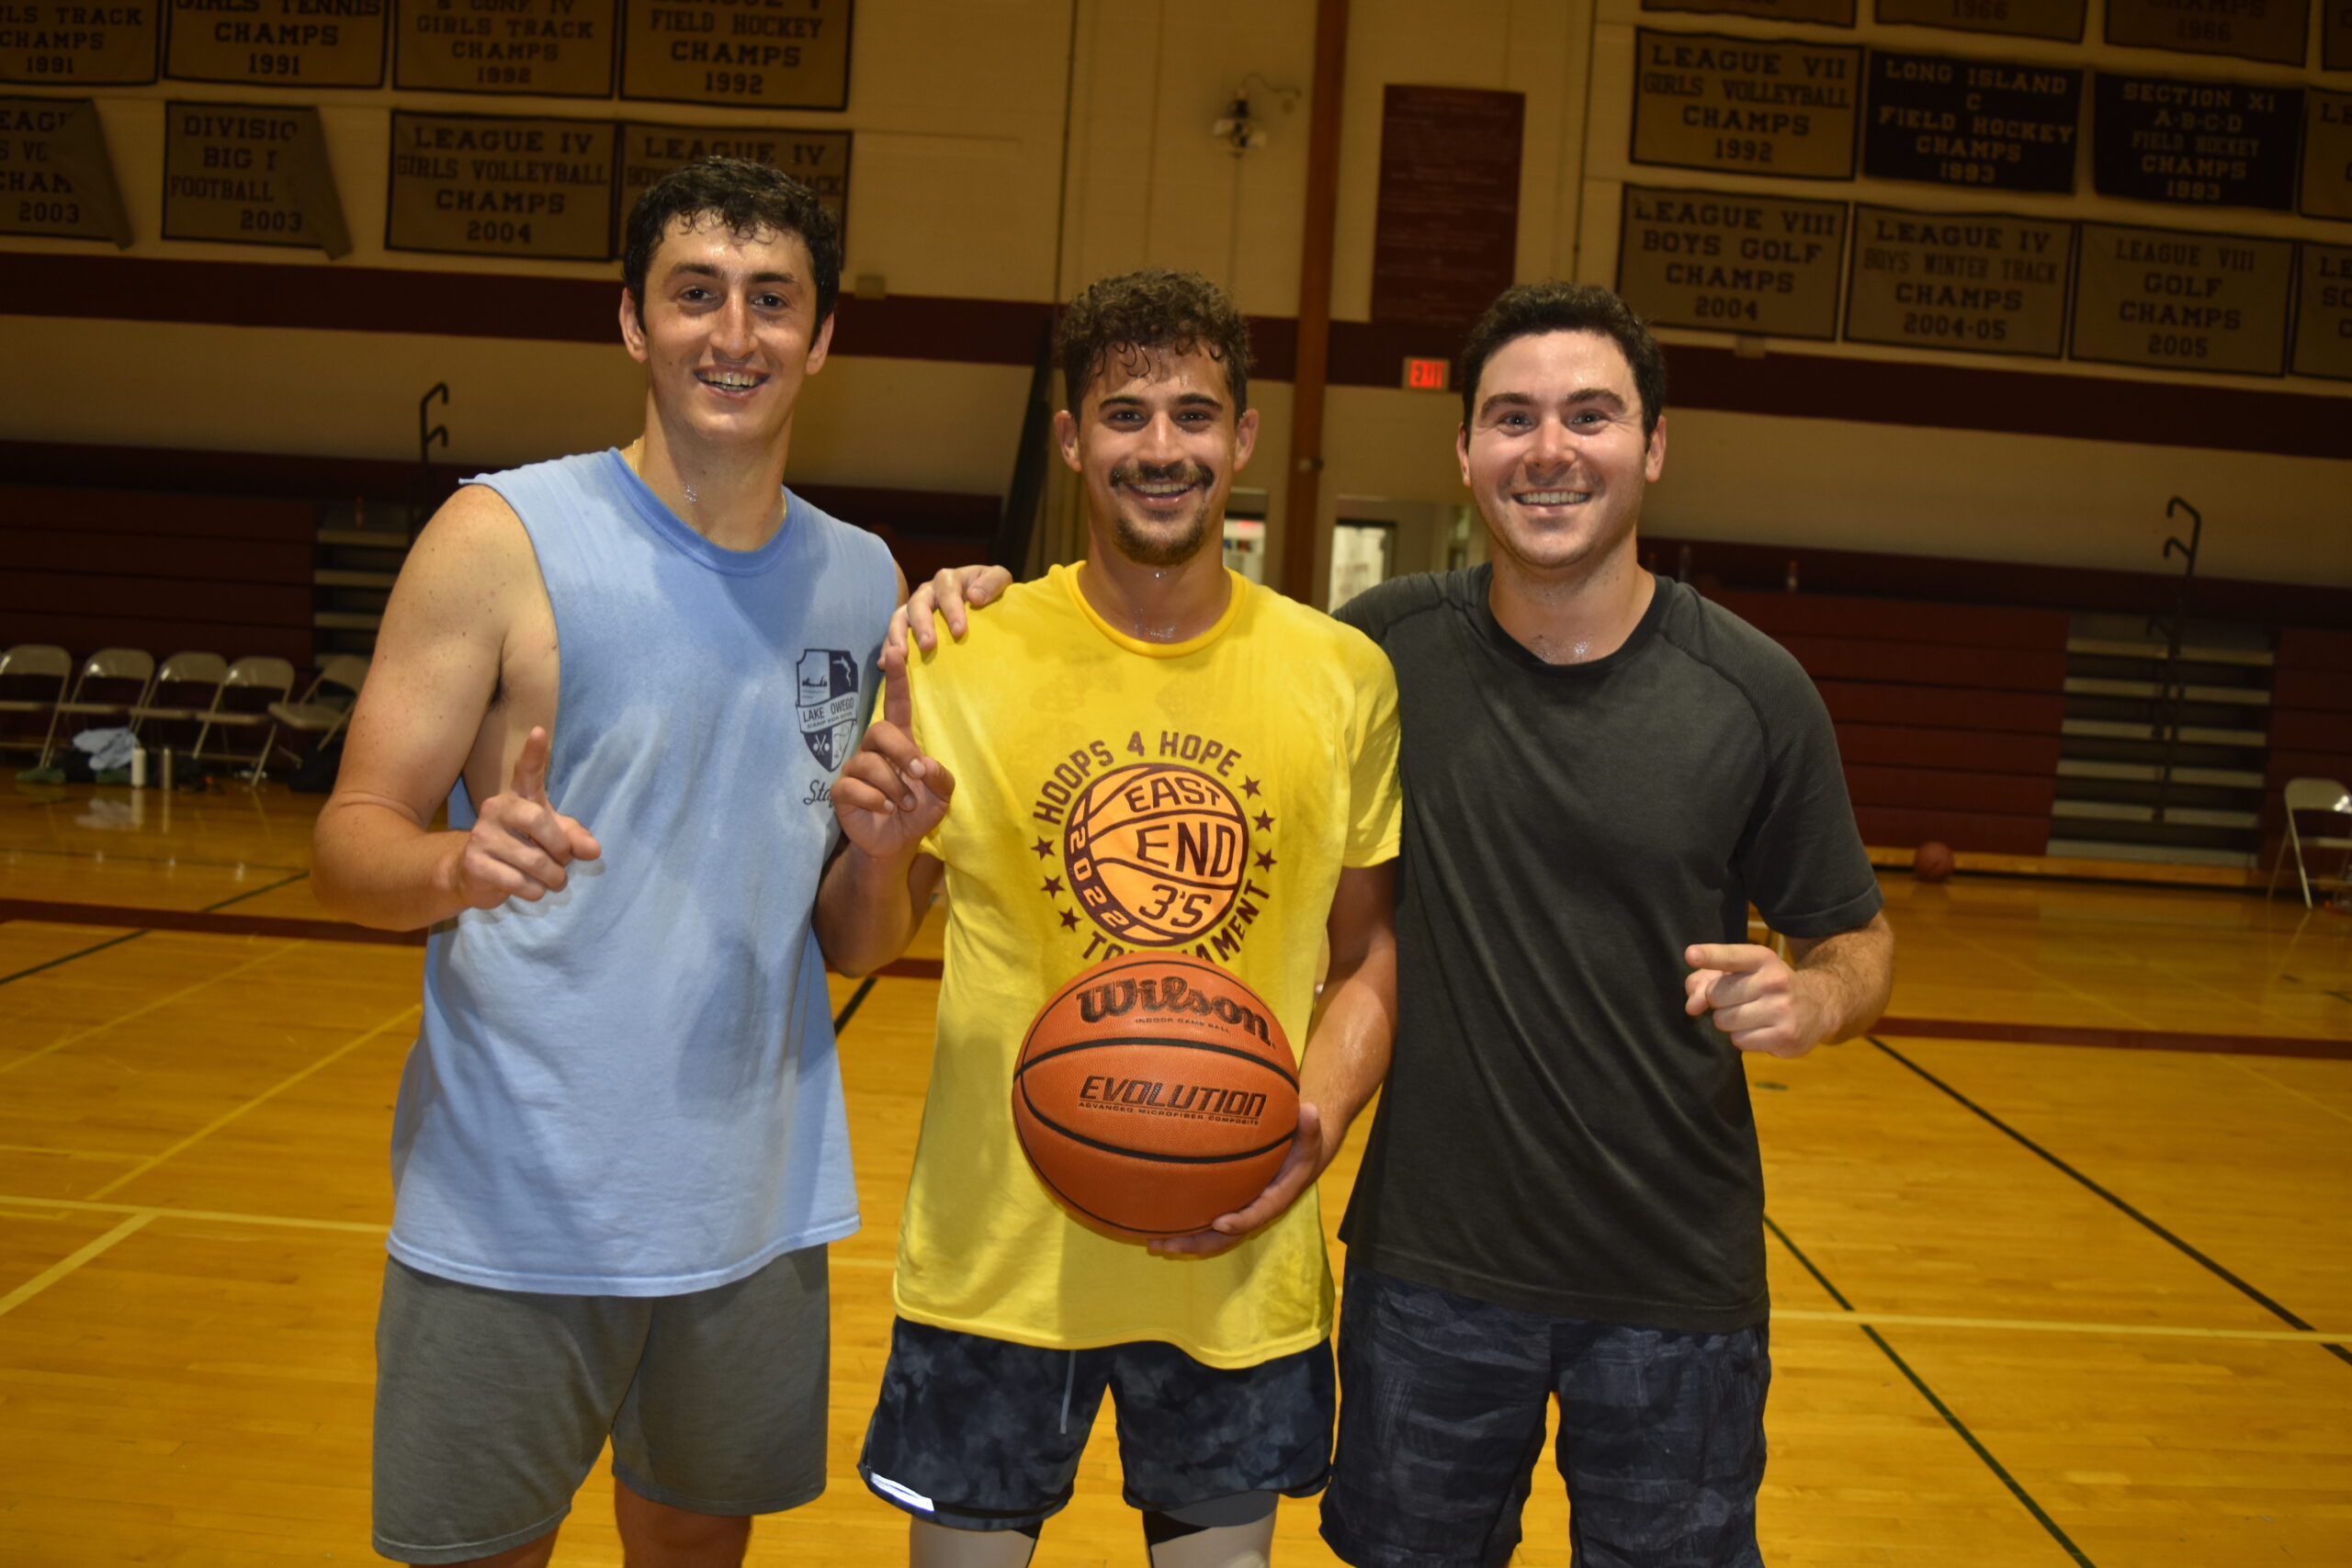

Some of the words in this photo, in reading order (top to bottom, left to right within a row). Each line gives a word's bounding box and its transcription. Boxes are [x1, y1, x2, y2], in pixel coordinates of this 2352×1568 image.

[55, 7, 143, 26] TRACK
[416, 15, 493, 36] GIRLS
[505, 18, 594, 39] TRACK
[650, 9, 716, 33] FIELD
[732, 14, 823, 39] HOCKEY
[0, 30, 105, 51] CHAMPS
[215, 22, 339, 45] CHAMPS
[248, 53, 301, 74] 1991
[451, 40, 560, 62] CHAMPS
[671, 40, 802, 67] CHAMPS
[1653, 45, 1781, 75] LEAGUE
[1803, 55, 1847, 80] VII
[705, 71, 764, 94] 1992
[1643, 72, 1705, 97] GIRLS
[1722, 79, 1849, 109] VOLLEYBALL
[1886, 60, 1953, 84] LONG
[1968, 68, 2067, 95] ISLAND
[1965, 93, 1983, 112] C
[2122, 82, 2233, 108] SECTION
[2248, 92, 2276, 112] XI
[1682, 105, 1811, 137] CHAMPS
[1879, 105, 1957, 132] FIELD
[1973, 116, 2075, 144] HOCKEY
[414, 126, 544, 152] LEAGUE
[560, 132, 594, 154] IV
[1713, 138, 1773, 163] 1992
[1916, 134, 2022, 164] CHAMPS
[2132, 130, 2184, 152] FIELD
[2195, 135, 2261, 158] HOCKEY
[203, 146, 254, 169] BIG
[794, 144, 825, 166] IV
[2141, 154, 2248, 179] CHAMPS
[396, 154, 458, 179] GIRLS
[472, 160, 608, 186] VOLLEYBALL
[169, 175, 276, 203] FOOTBALL
[435, 189, 566, 215] CHAMPS
[18, 201, 80, 223] 2003
[240, 209, 303, 233] 2003
[1633, 198, 1763, 231] LEAGUE
[1781, 209, 1836, 237] VIII
[467, 220, 532, 244] 2004
[1875, 219, 2004, 250] LEAGUE
[2018, 230, 2052, 254] IV
[1643, 229, 1723, 257] BOYS
[1740, 237, 1822, 265] GOLF
[2115, 239, 2201, 267] LEAGUE
[2219, 248, 2255, 273] VIII
[1664, 262, 1795, 294] CHAMPS
[1863, 247, 1911, 274] BOYS
[1924, 254, 1989, 278] WINTER
[2001, 258, 2058, 285] TRACK
[1894, 282, 2024, 311] CHAMPS
[2143, 273, 2223, 298] GOLF
[1693, 295, 1758, 321] 2004
[2119, 299, 2242, 331] CHAMPS
[2147, 333, 2209, 359] 2005
[802, 706, 825, 723] LAKE
[831, 697, 854, 715] OWEGO
[1032, 739, 1115, 826] HOOPS
[1126, 730, 1146, 758] 4
[1159, 730, 1242, 778] HOPE
[803, 779, 835, 808] Sta
[1125, 777, 1221, 813] EAST
[1136, 820, 1237, 878] END
[1069, 825, 1131, 929] 2022
[1076, 976, 1273, 1048] Wilson
[1177, 1018, 1205, 1027] GAME
[1208, 1022, 1230, 1033] BALL
[1079, 1075, 1268, 1118] EVOLUTION
[1079, 1102, 1134, 1113] ADVANCED
[1138, 1108, 1204, 1120] MICROFIBER
[1208, 1114, 1260, 1127] COMPOSITE
